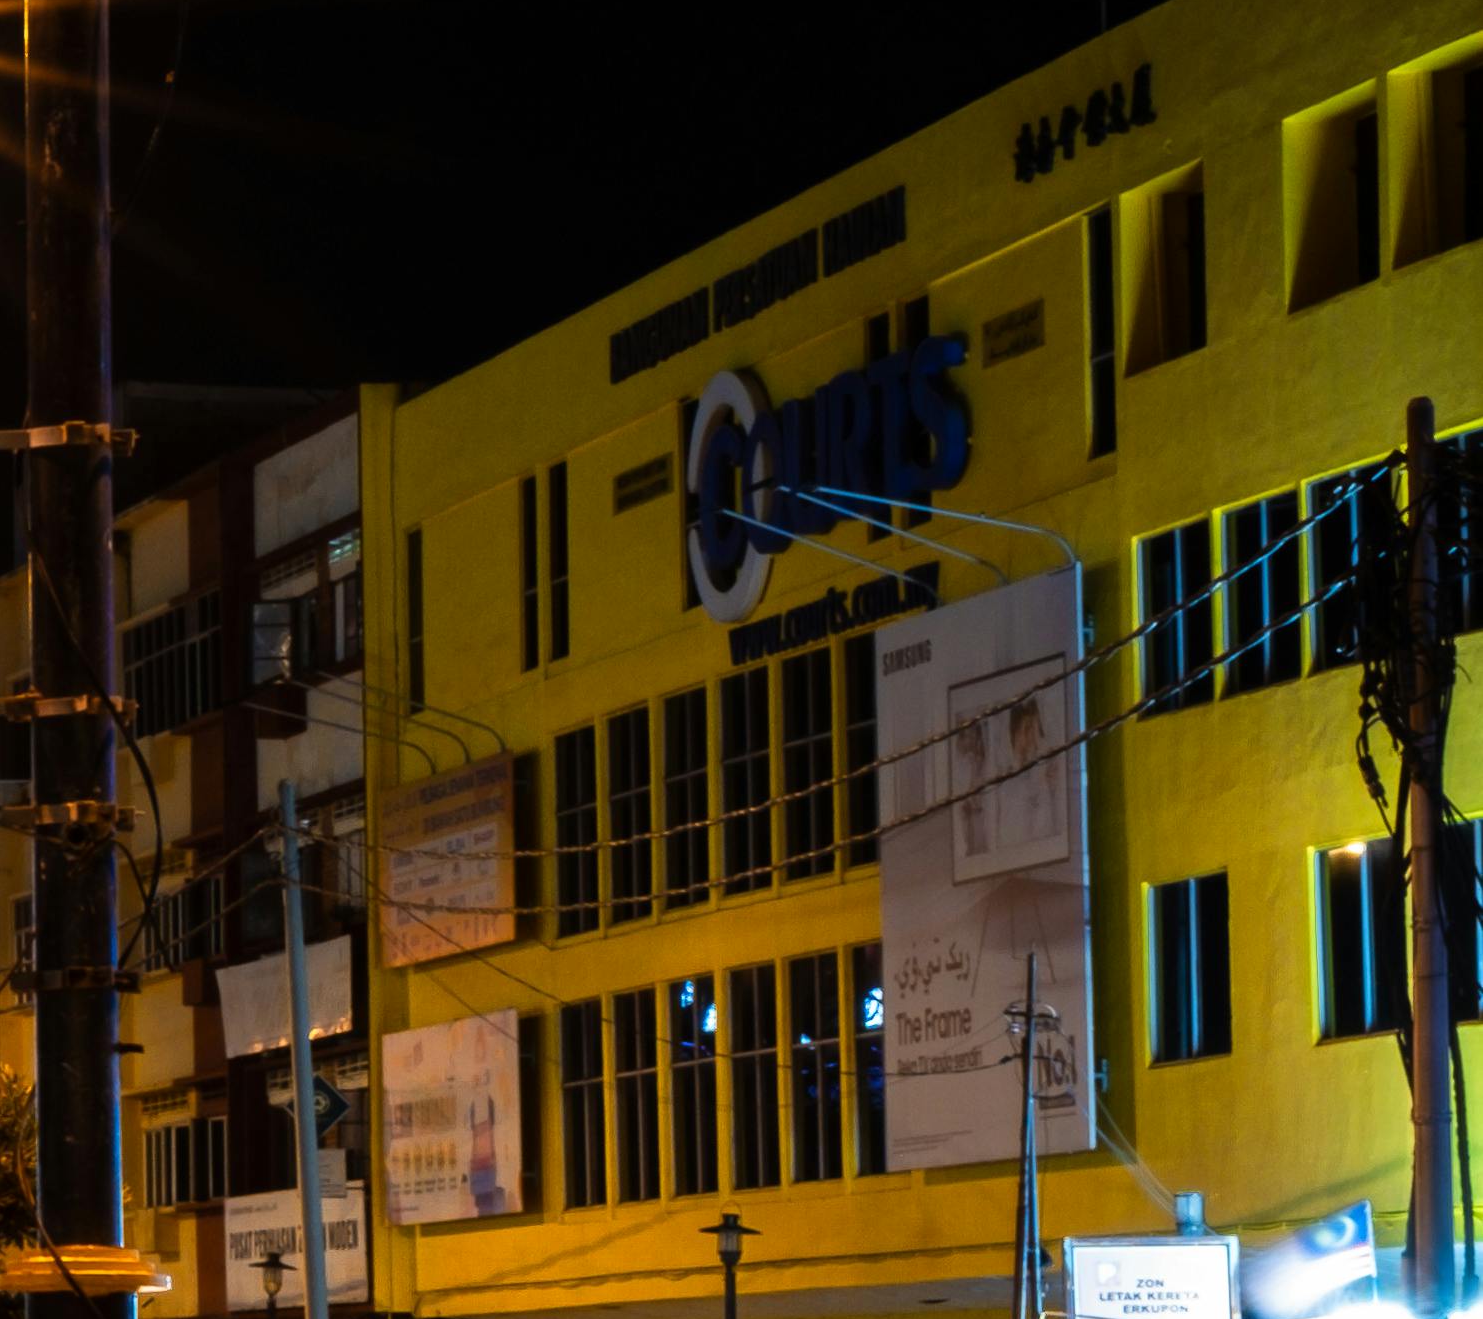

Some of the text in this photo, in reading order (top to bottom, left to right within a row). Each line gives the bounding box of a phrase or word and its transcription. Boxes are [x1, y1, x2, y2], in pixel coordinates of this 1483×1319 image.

[699, 330, 970, 570] COURTS
[882, 639, 932, 677] SAMSUNG
[895, 1007, 972, 1046] The Frame
[1099, 1291, 1142, 1303] LETAK
[1136, 1279, 1165, 1289] ZON
